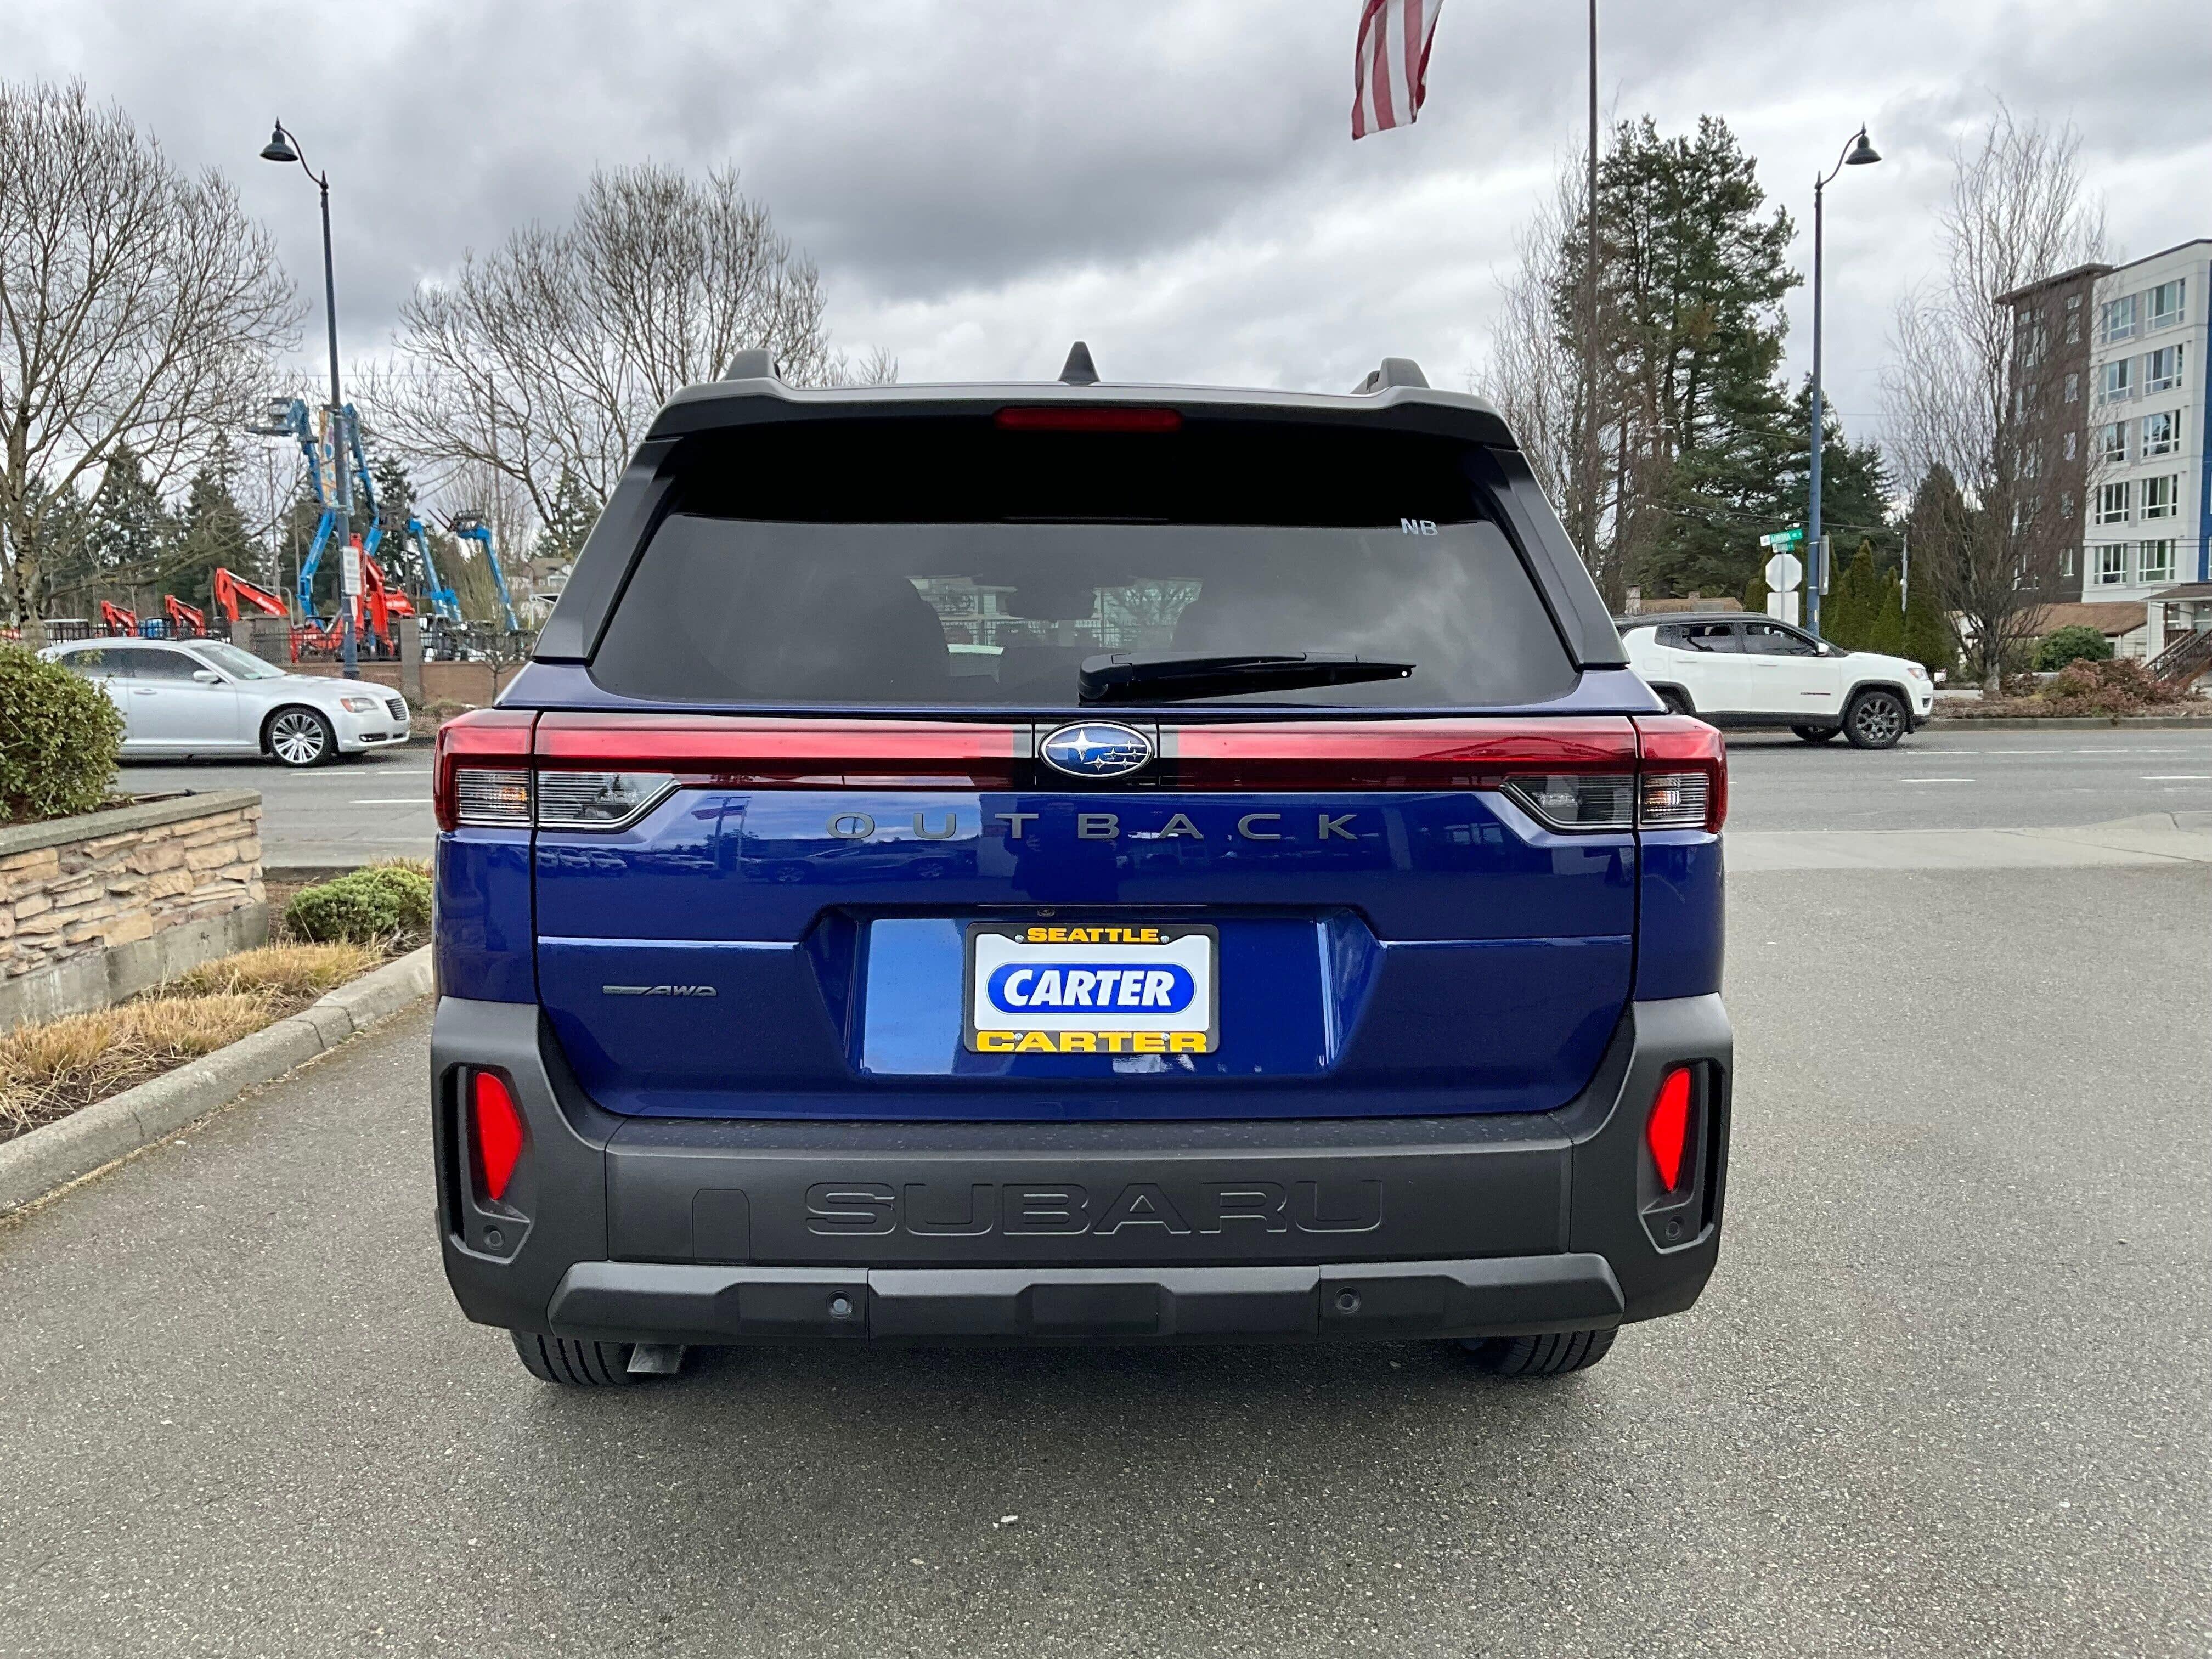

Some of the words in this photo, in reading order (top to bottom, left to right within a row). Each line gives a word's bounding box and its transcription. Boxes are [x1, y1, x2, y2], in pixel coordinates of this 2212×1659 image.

[1401, 518, 1438, 535] NB
[826, 813, 1358, 839] OUTBACK
[1027, 927, 1159, 943] SEATTLE
[645, 985, 718, 996] AWD
[1003, 969, 1175, 1006] CARTER
[977, 1031, 1206, 1052] CARTER
[805, 1180, 1383, 1235] SUBARU
